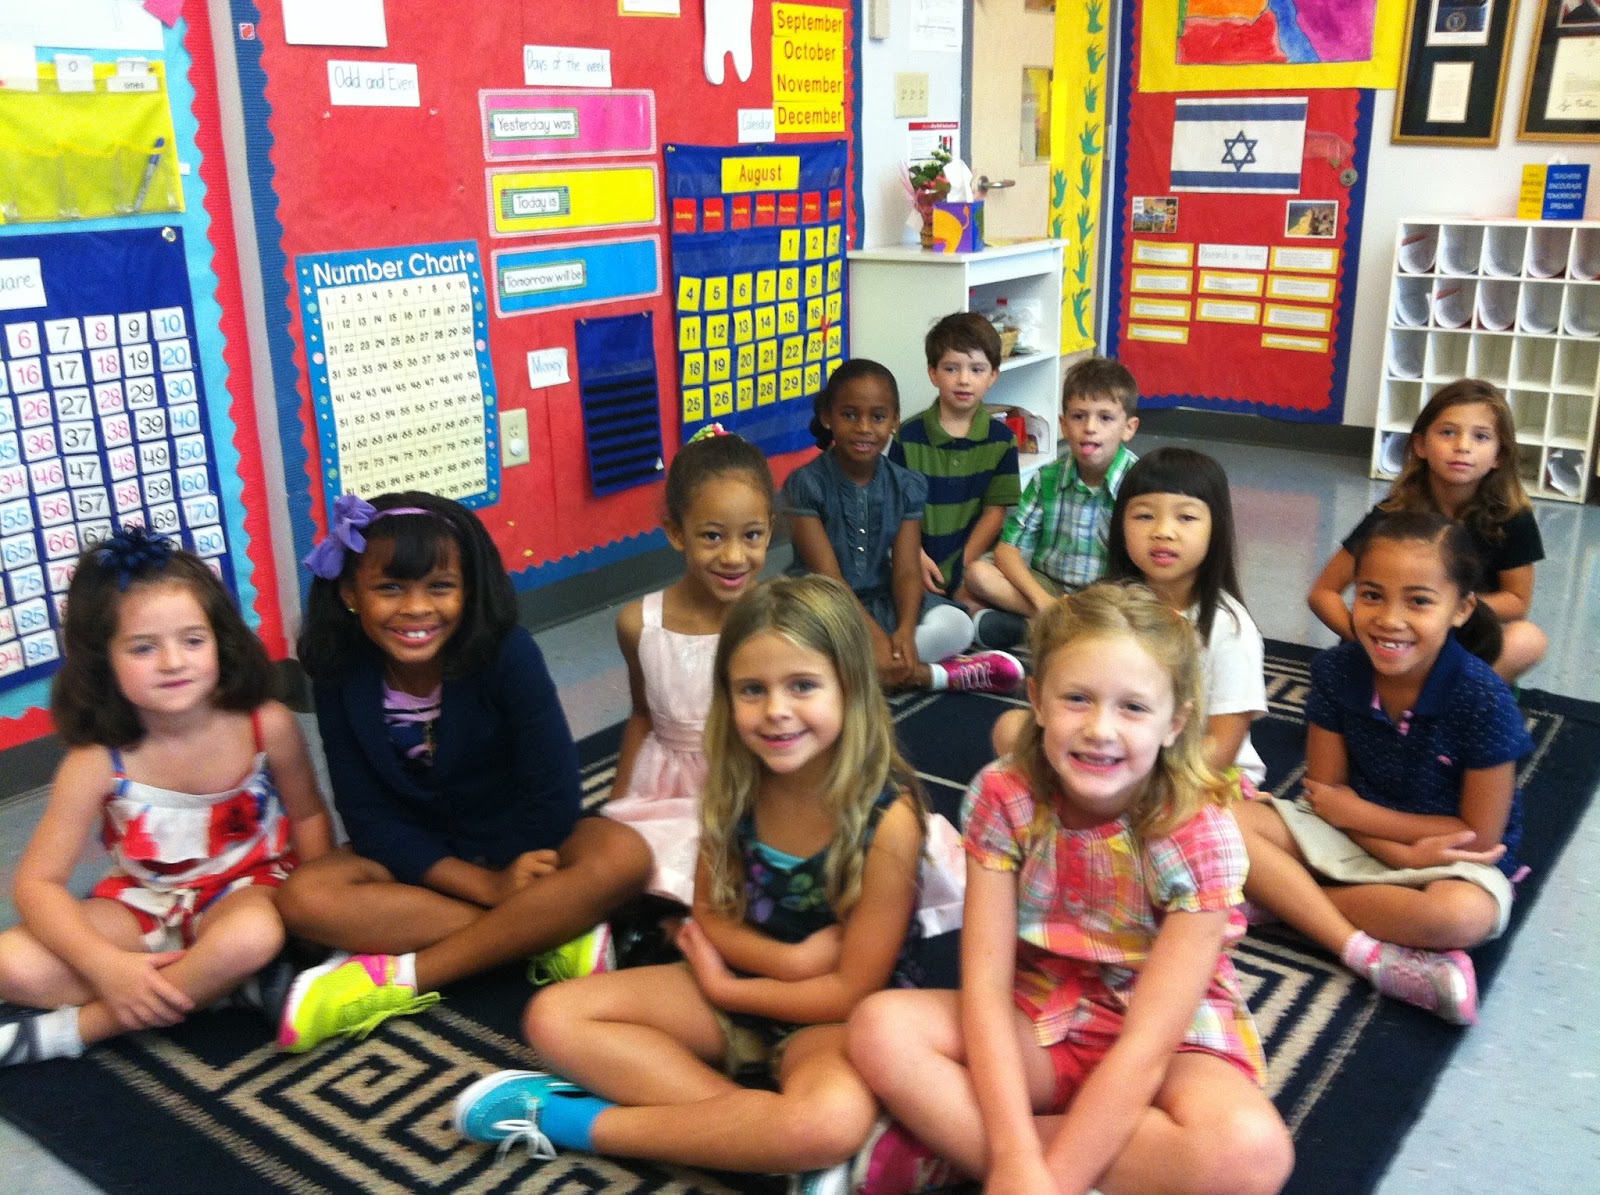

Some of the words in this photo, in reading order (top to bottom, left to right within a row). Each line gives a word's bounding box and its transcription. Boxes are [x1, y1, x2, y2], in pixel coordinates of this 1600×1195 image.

[776, 9, 842, 34] September
[526, 50, 549, 72] Days
[552, 52, 561, 70] of
[587, 55, 606, 73] week
[784, 40, 836, 61] October
[334, 65, 361, 89] Odd
[365, 67, 385, 90] and
[388, 67, 415, 91] Even
[777, 74, 842, 93] November
[497, 118, 550, 135] Yesterday
[552, 119, 572, 131] was
[778, 106, 841, 125] December
[739, 164, 782, 186] August
[516, 196, 547, 212] Today
[549, 197, 557, 207] is
[789, 238, 793, 250] 1
[812, 236, 818, 249] 2
[313, 258, 404, 287] Number
[408, 249, 468, 276] Chart
[506, 275, 554, 288] Tomorrow
[341, 296, 347, 304] 2
[357, 293, 362, 302] 3
[372, 292, 378, 300] 4
[388, 290, 393, 298] 5
[418, 286, 422, 294] 7
[459, 281, 466, 289] 10
[686, 288, 694, 299] 4
[713, 286, 721, 300] 5
[739, 284, 746, 297] 6
[764, 280, 770, 292] 7
[786, 277, 793, 290] 8
[810, 275, 817, 288] 9
[831, 269, 839, 282] 10
[18, 330, 32, 349] 6
[56, 326, 70, 345] 7
[95, 322, 108, 341] 8
[128, 319, 140, 338] 9
[160, 314, 181, 333] 10
[327, 322, 334, 331] 11
[343, 320, 351, 328] 12
[358, 317, 366, 326] 13
[374, 315, 382, 324] 14
[389, 314, 397, 322] 15
[419, 309, 426, 319] 17
[433, 307, 441, 316] 18
[447, 305, 455, 315] 19
[460, 303, 470, 312] 20
[686, 328, 696, 340] 11
[713, 325, 725, 338] 12
[739, 321, 749, 333] 13
[760, 316, 771, 327] 14
[784, 311, 795, 323] 15
[811, 307, 820, 319] 16
[830, 301, 838, 313] 17
[329, 346, 338, 355] 21
[344, 344, 354, 353] 22
[360, 341, 370, 351] 23
[375, 339, 385, 349] 24
[391, 337, 400, 346] 25
[420, 332, 429, 342] 27
[435, 330, 444, 339] 28
[448, 328, 458, 337] 29
[461, 326, 471, 335] 30
[16, 364, 40, 385] 16
[55, 360, 79, 381] 17
[97, 354, 118, 374] 18
[129, 350, 149, 370] 19
[162, 346, 187, 366] 20
[332, 370, 341, 380] 31
[347, 368, 357, 377] 32
[362, 365, 373, 375] 33
[378, 363, 388, 372] 34
[422, 355, 431, 365] 37
[463, 349, 473, 358] 40
[532, 356, 562, 376] Money
[689, 362, 701, 375] 18
[714, 358, 726, 371] 19
[740, 353, 751, 367] 20
[763, 350, 774, 363] 21
[786, 345, 799, 358] 22
[809, 340, 821, 352] 23
[830, 336, 839, 349] 24
[23, 399, 50, 420] 26
[60, 395, 87, 416] 27
[100, 388, 121, 409] 28
[130, 384, 154, 404] 29
[168, 379, 192, 398] 30
[686, 399, 700, 412] 25
[714, 392, 729, 406] 26
[741, 387, 751, 400] 27
[760, 382, 773, 396] 28
[784, 377, 799, 391] 29
[807, 372, 820, 386] 30
[28, 432, 54, 454] 36
[64, 428, 92, 448] 37
[106, 420, 130, 441] 38
[139, 415, 163, 434] 39
[173, 409, 197, 428] 40
[35, 465, 62, 484] 46
[70, 462, 97, 480] 47
[114, 452, 135, 472] 48
[143, 447, 167, 466] 49
[180, 441, 204, 460] 50
[2, 511, 29, 530] 55
[42, 501, 70, 520] 56
[79, 493, 104, 514] 57
[118, 486, 139, 506] 58
[148, 478, 171, 499] 59
[182, 472, 206, 492] 60
[5, 541, 32, 563] 65
[48, 533, 76, 553] 66
[153, 509, 176, 530] 69
[193, 502, 216, 521] 70
[14, 571, 42, 594] 75
[199, 533, 222, 552] 80
